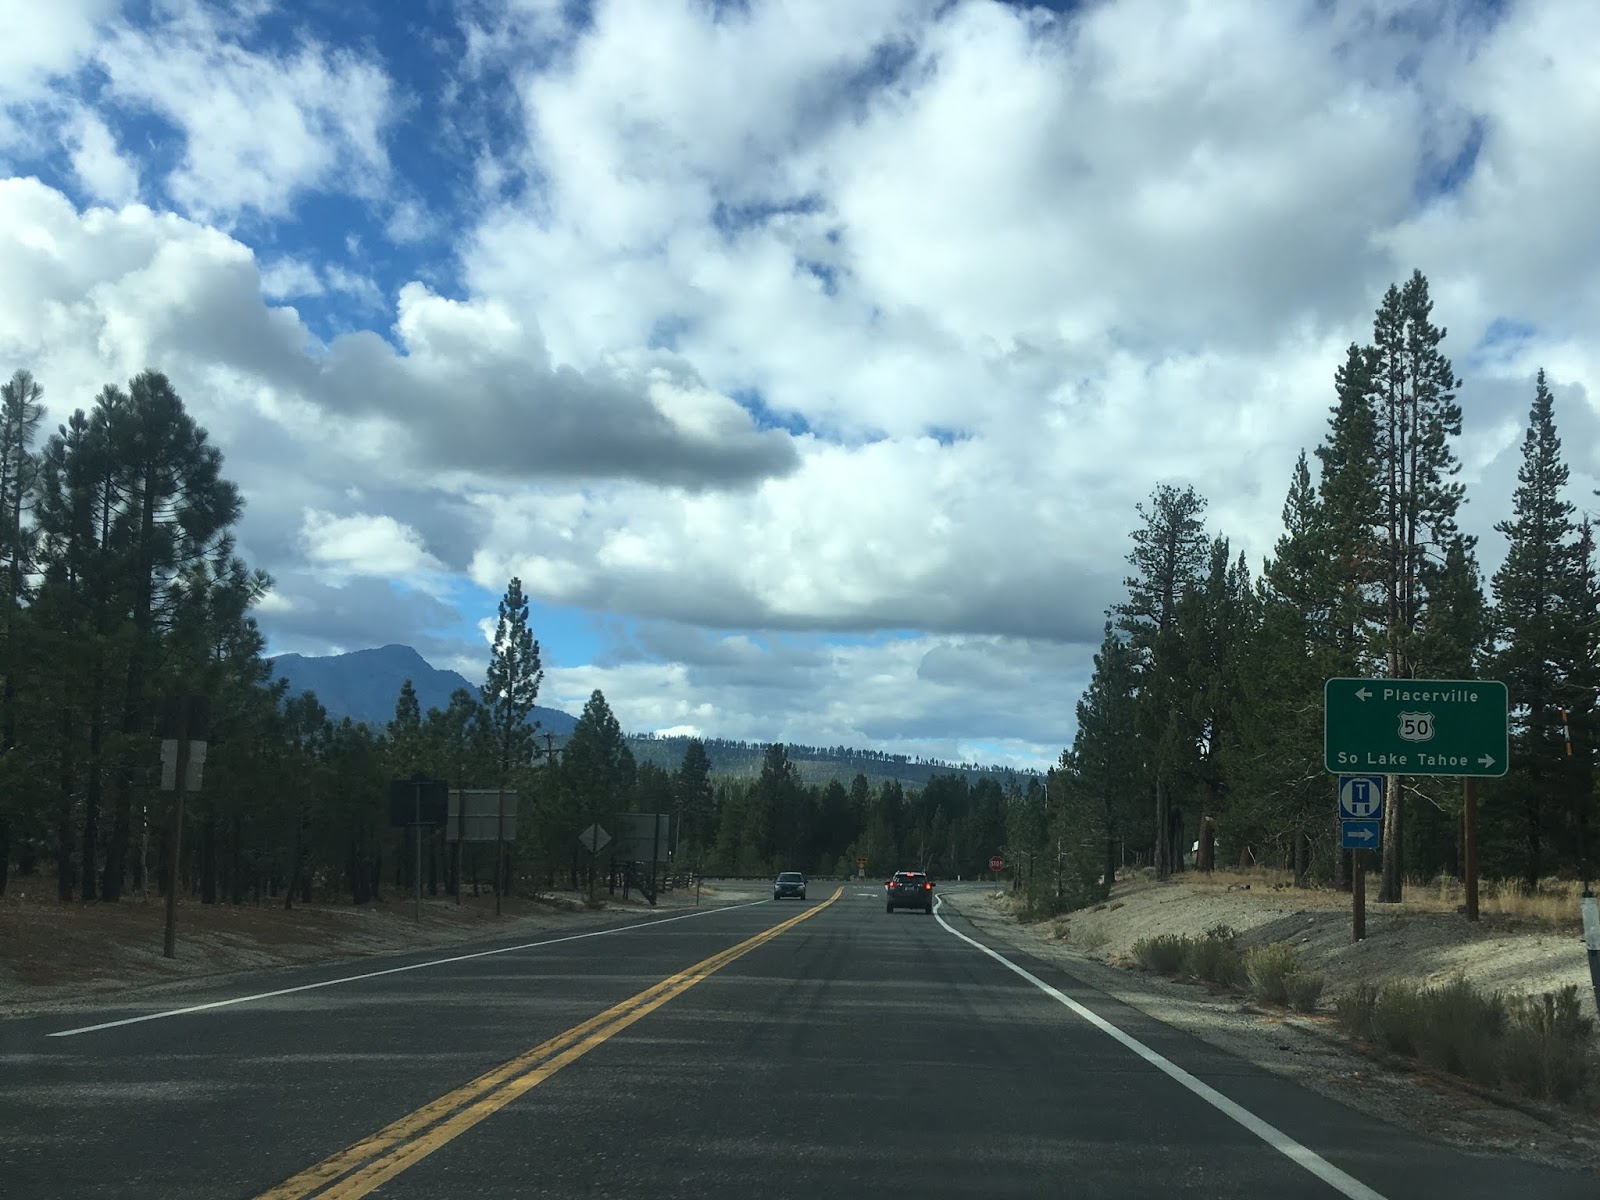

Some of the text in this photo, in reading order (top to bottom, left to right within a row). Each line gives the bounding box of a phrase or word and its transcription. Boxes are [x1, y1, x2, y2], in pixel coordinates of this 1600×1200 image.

[1383, 688, 1478, 702] Placerville
[1405, 720, 1428, 735] 50
[1338, 751, 1468, 766] So Lake Tahoe
[1356, 784, 1365, 799] T
